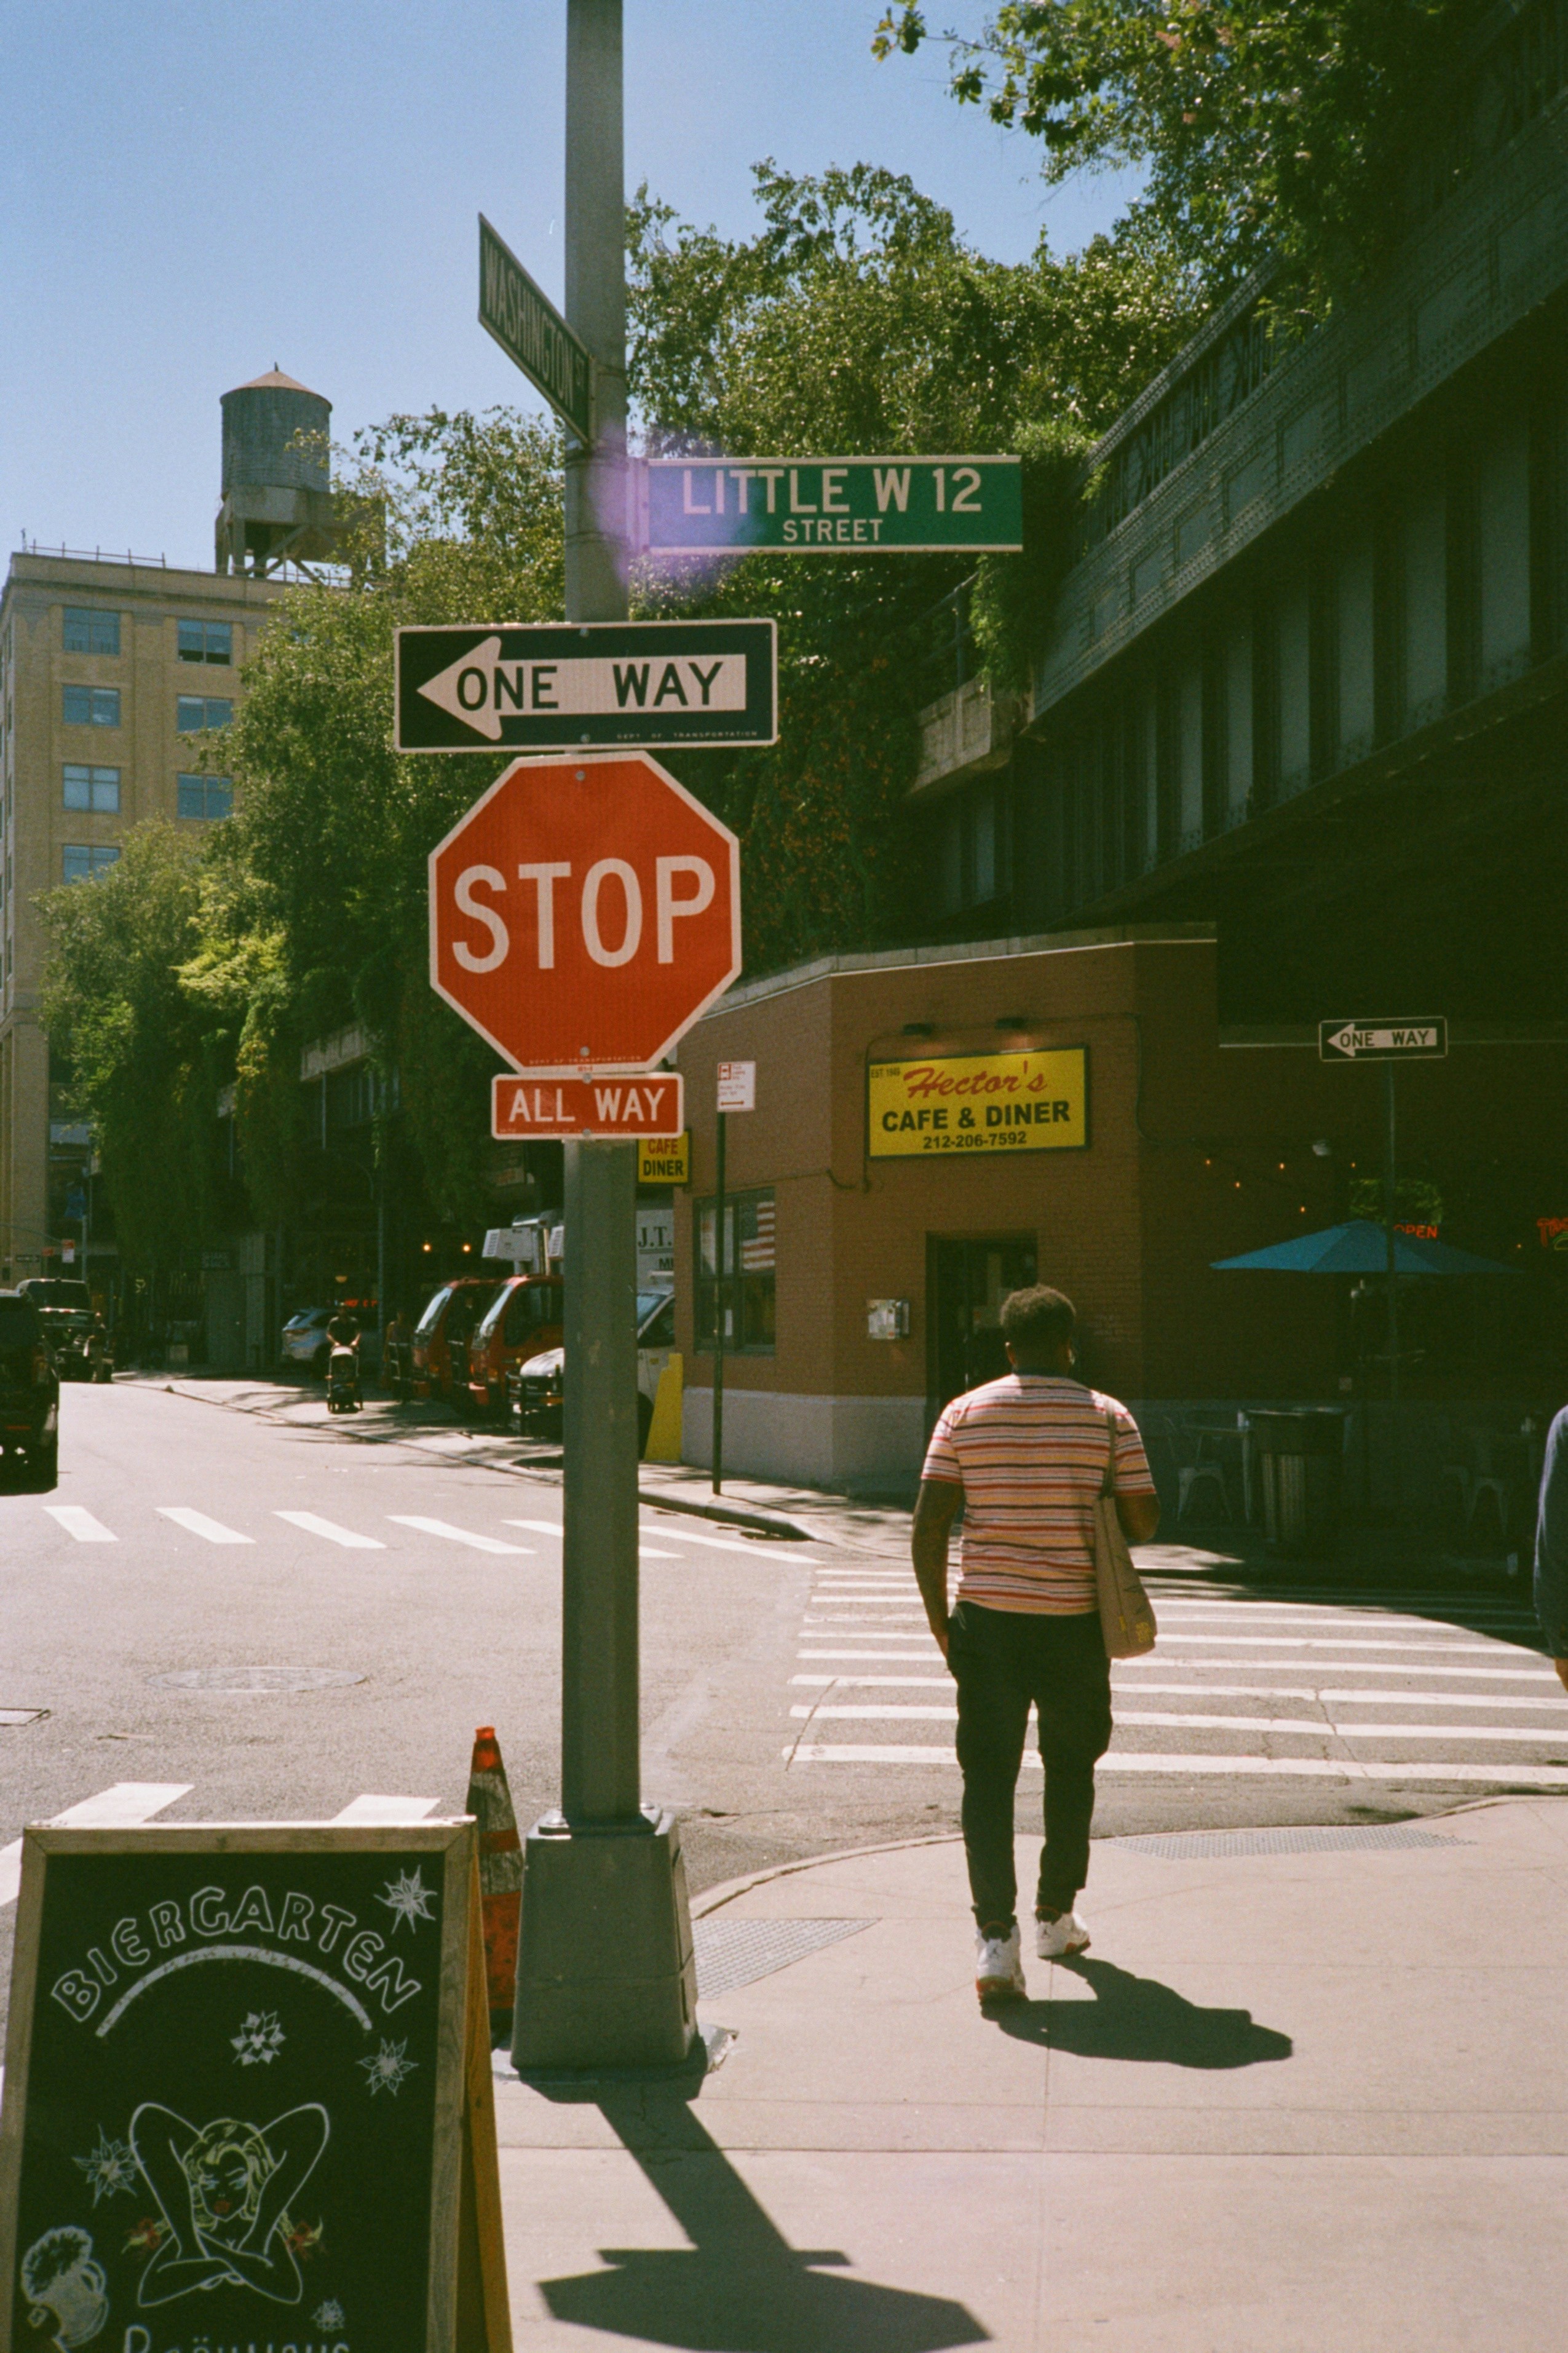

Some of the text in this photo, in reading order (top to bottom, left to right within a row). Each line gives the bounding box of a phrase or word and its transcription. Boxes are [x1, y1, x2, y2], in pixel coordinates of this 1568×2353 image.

[485, 237, 574, 411] WASHINGTON
[683, 467, 982, 515] LITTLE W 12
[782, 518, 884, 543] STREET
[456, 660, 724, 711] ONE WAY
[452, 855, 716, 974] STOP
[1339, 1030, 1429, 1048] ONE WAY
[903, 1059, 1047, 1099] Hector's
[509, 1087, 666, 1123] ALL WAY
[882, 1100, 1071, 1132] CAFE & DINER
[647, 1137, 679, 1155] CAFE
[922, 1131, 1028, 1149] 212-206-7592
[643, 1160, 684, 1176] DINER
[50, 1884, 422, 2024] BIERGARTEN
